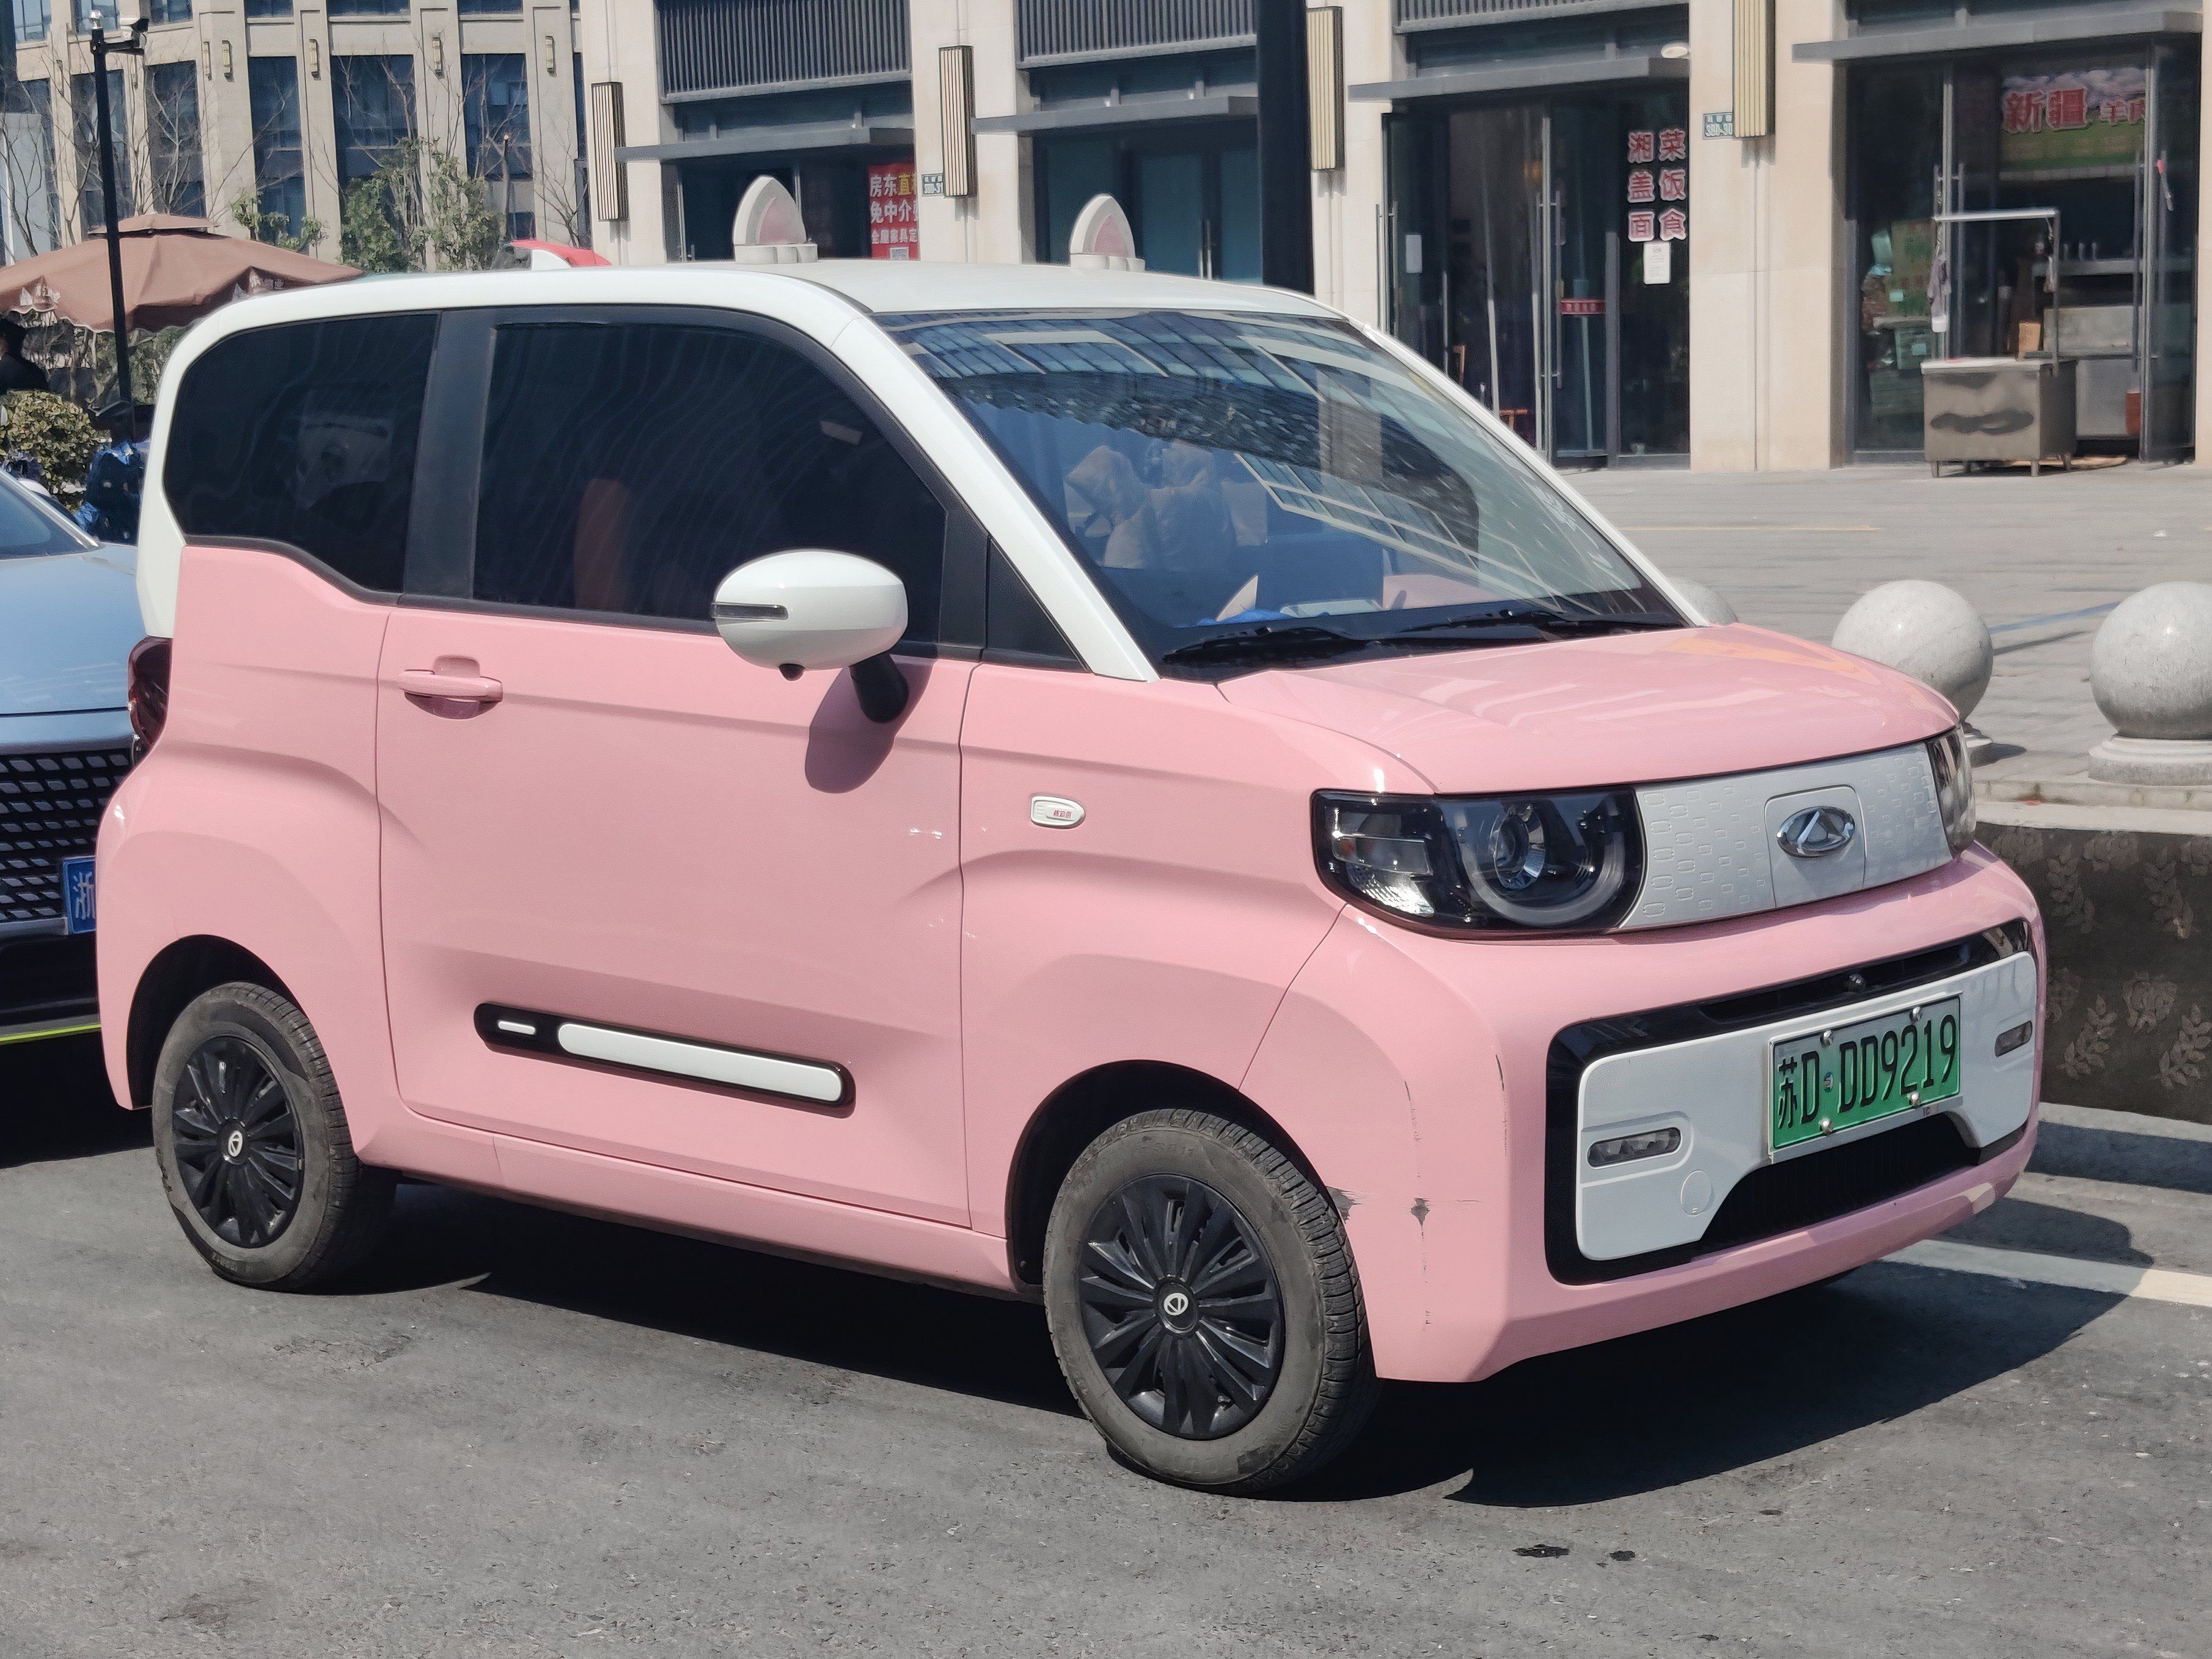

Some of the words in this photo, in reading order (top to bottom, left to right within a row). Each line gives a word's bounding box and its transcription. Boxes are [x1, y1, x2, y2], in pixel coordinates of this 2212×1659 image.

[2002, 87, 2087, 133] 新疆
[1628, 128, 1686, 164] 湘菜
[1627, 169, 1686, 203] 盖饭
[1628, 208, 1686, 241] 面食
